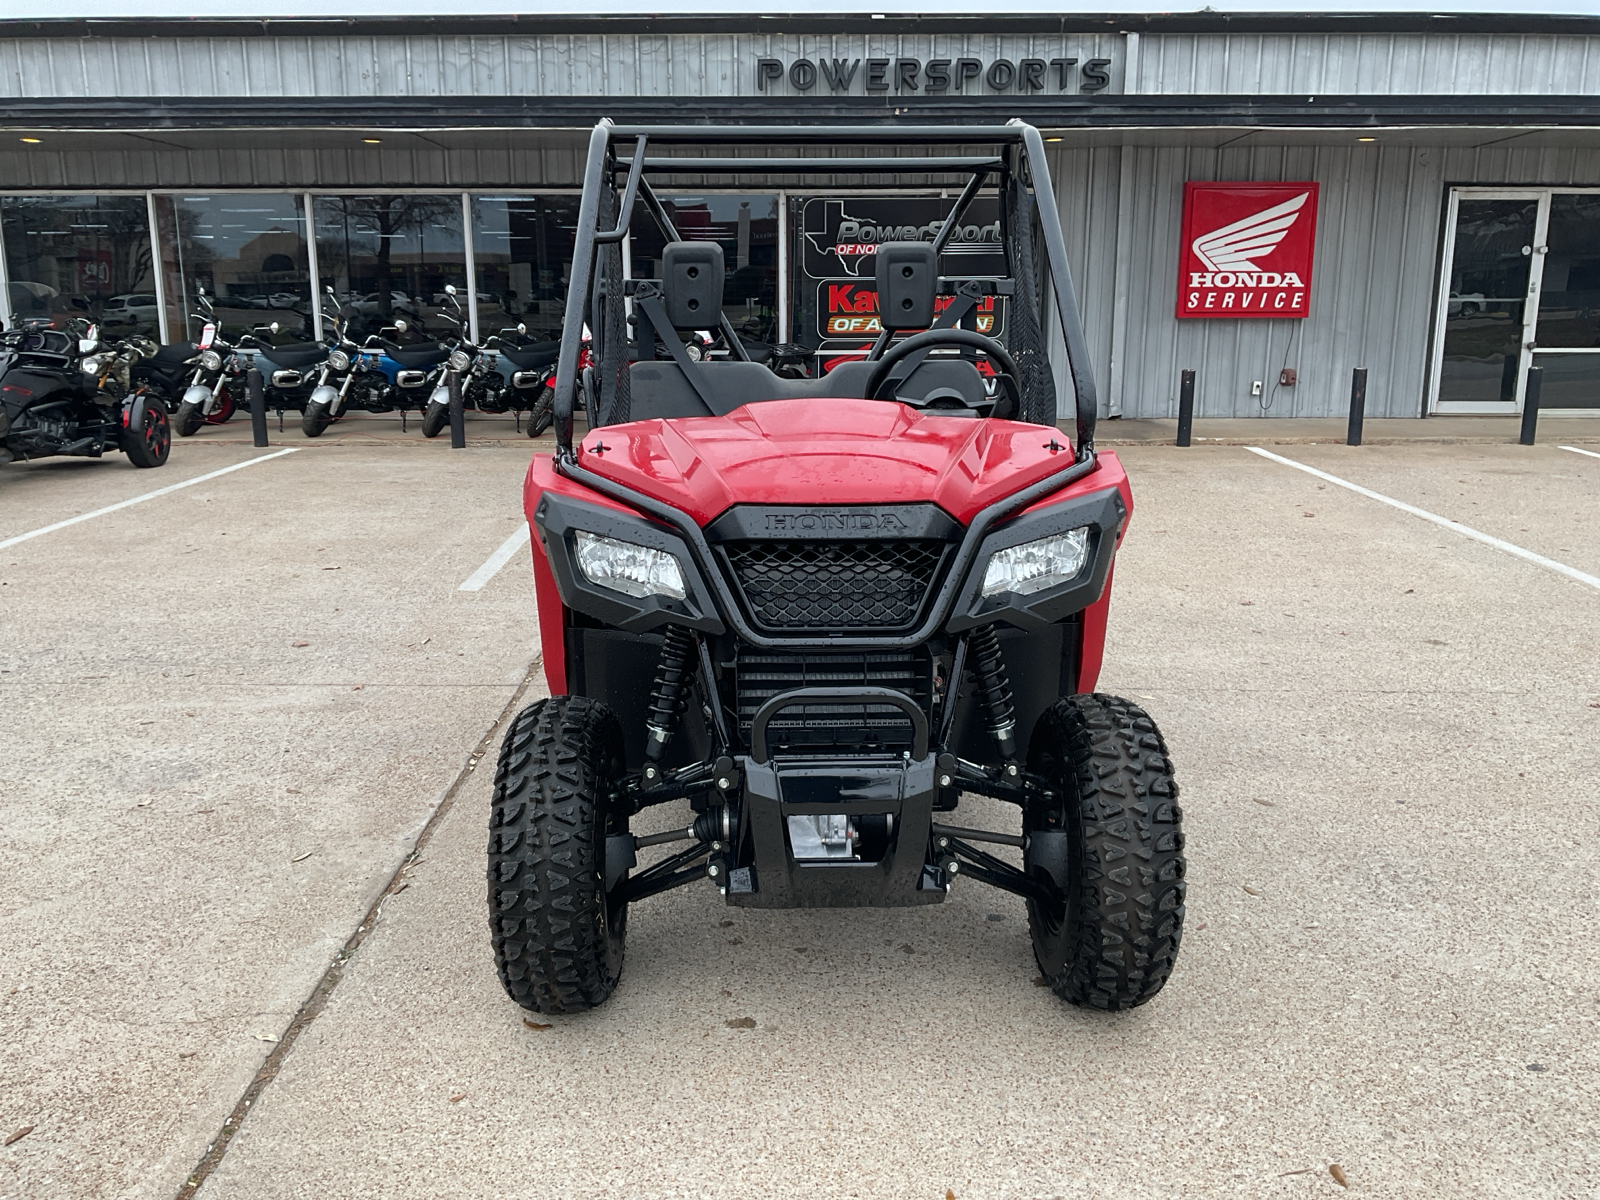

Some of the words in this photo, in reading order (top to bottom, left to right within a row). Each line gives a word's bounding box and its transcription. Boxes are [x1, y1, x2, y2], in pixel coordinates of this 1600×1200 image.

[757, 58, 1112, 91] POWERSPORTS
[837, 245, 855, 254] OF
[1188, 272, 1305, 288] HONDA
[1187, 292, 1304, 309] SERVICE
[833, 318, 864, 331] OF
[764, 513, 908, 530] HONDA
